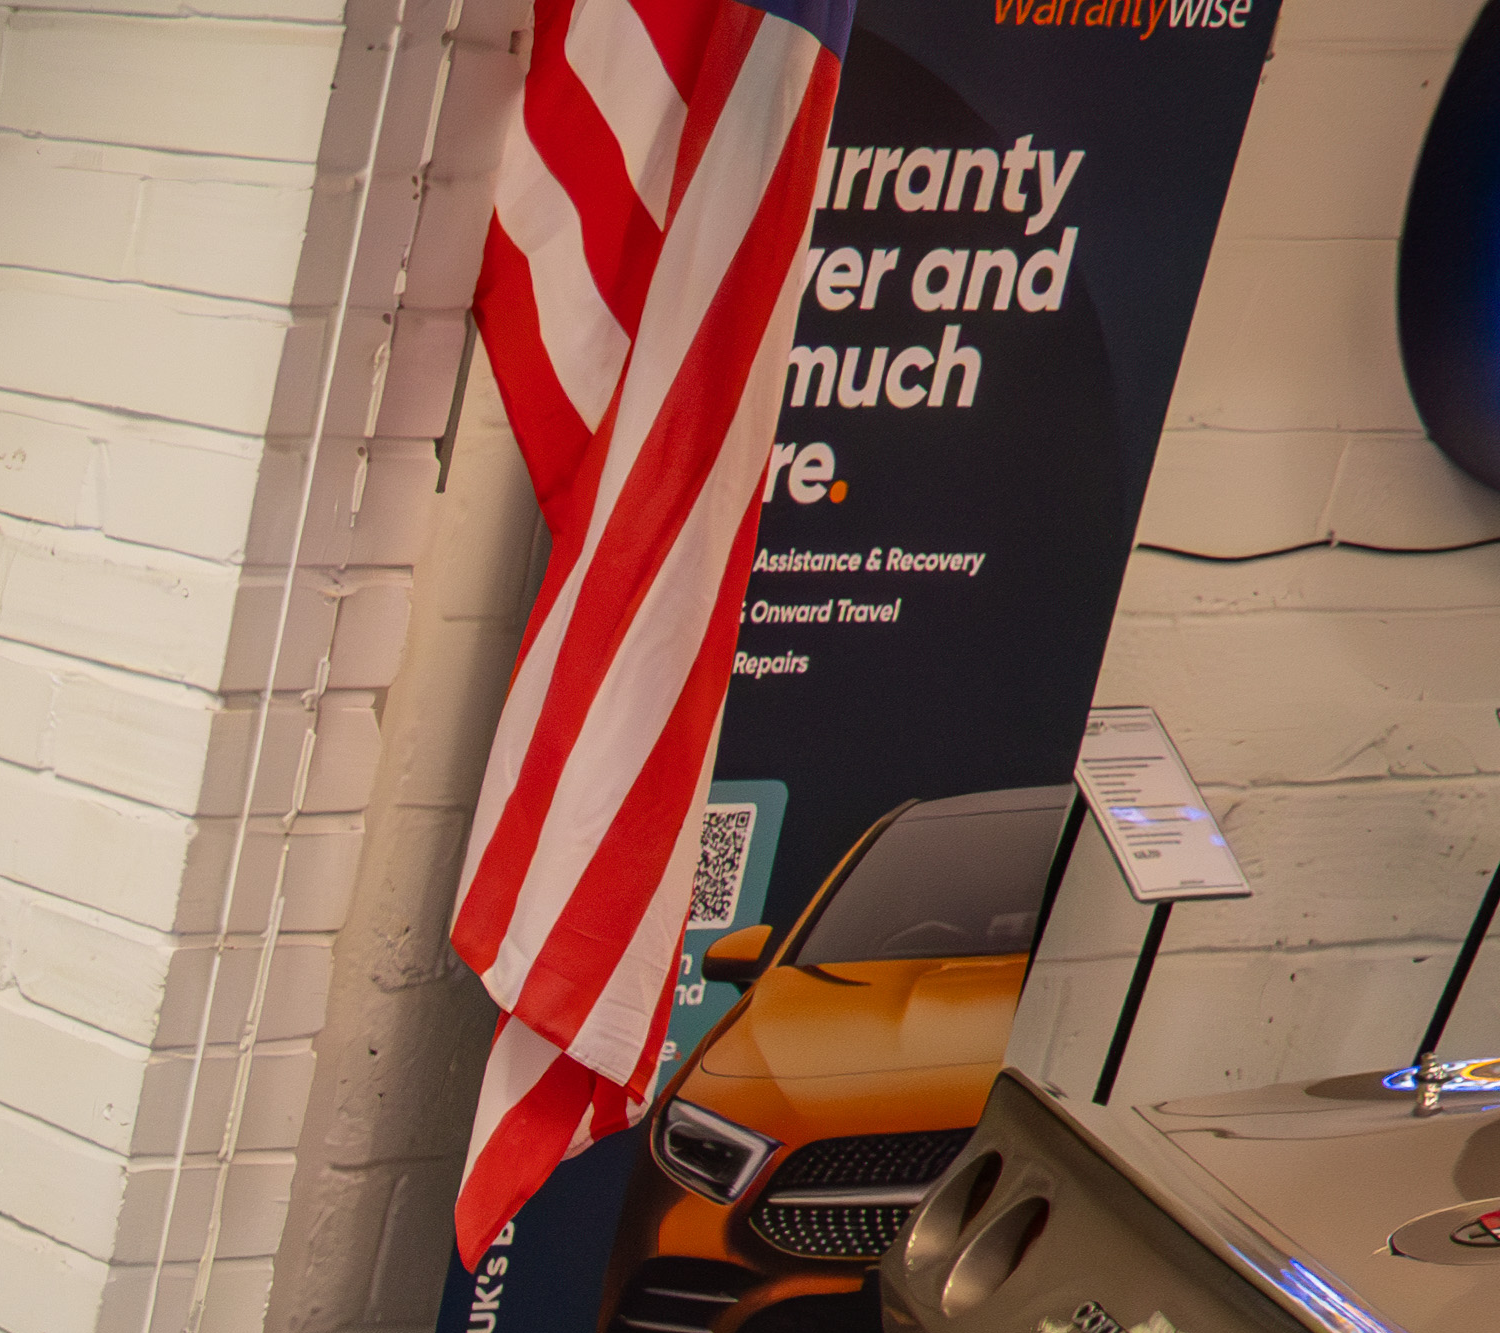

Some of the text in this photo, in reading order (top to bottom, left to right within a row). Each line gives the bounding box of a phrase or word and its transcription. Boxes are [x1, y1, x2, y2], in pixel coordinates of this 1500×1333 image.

[911, 227, 1080, 312] and
[788, 324, 983, 409] much
[752, 547, 986, 577] Assistance & Recovery
[750, 599, 834, 623] Onward
[837, 598, 902, 623] Travel
[732, 650, 810, 679] Repairs
